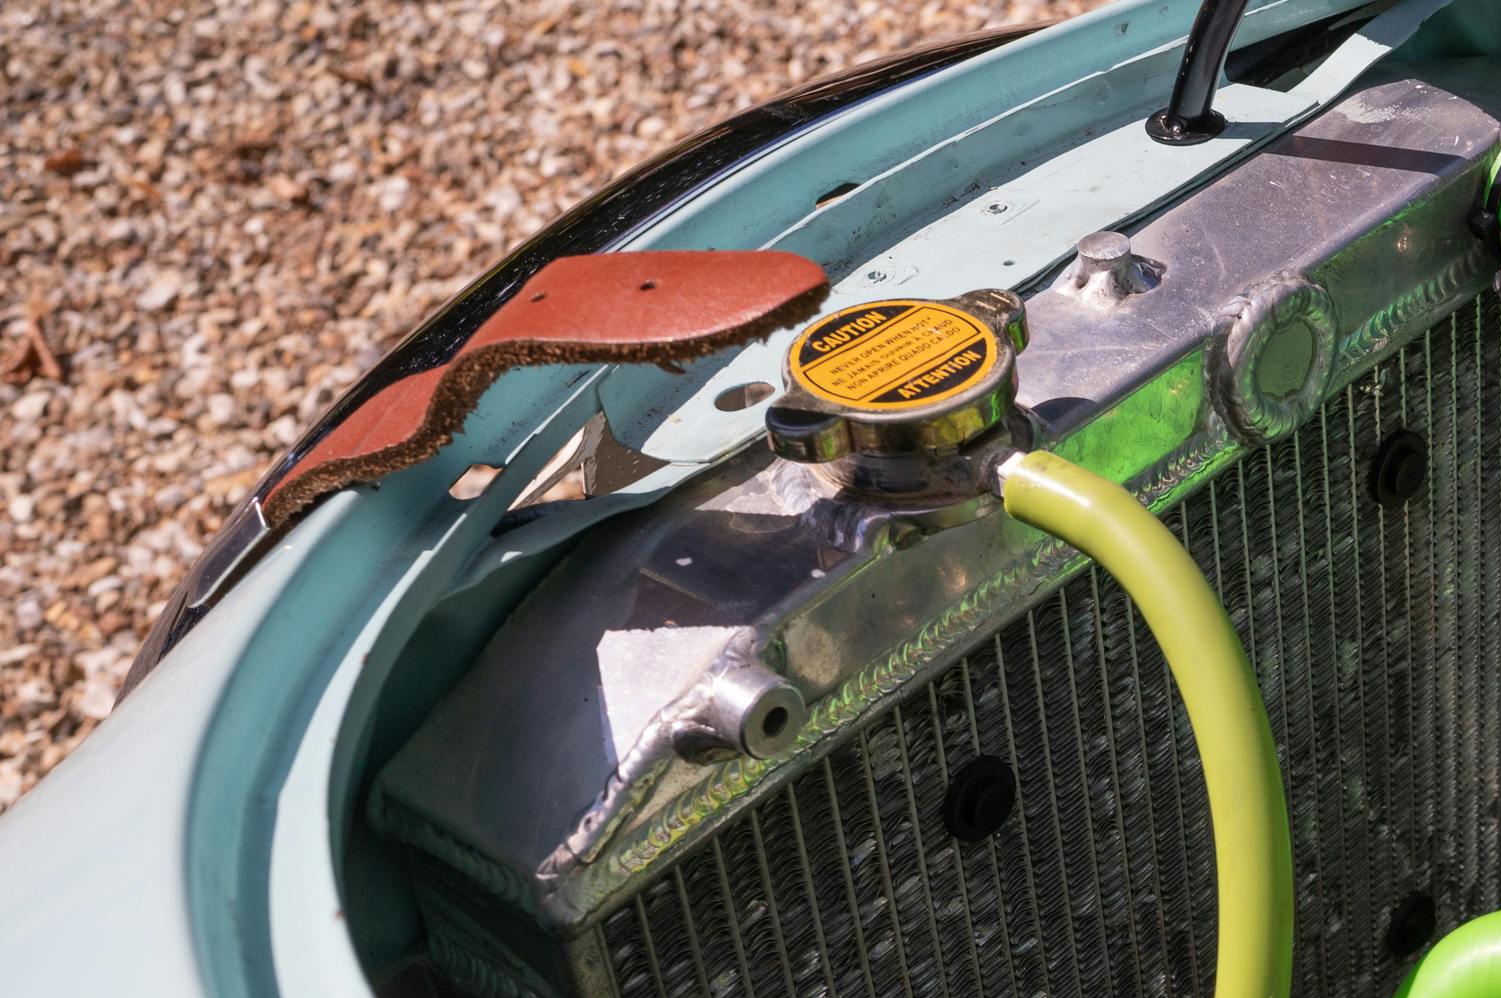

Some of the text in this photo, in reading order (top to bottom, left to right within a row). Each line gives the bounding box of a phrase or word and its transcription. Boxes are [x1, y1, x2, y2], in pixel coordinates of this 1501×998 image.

[812, 311, 888, 353] CAUTION
[830, 357, 861, 375] NEVER
[860, 344, 886, 359] OPEN
[885, 330, 912, 345] WHEN
[832, 378, 847, 386] NE
[848, 360, 881, 378] JAMAIS
[847, 378, 868, 390] NON
[867, 359, 901, 379] APRIRE
[897, 350, 982, 399] ATTENTION
